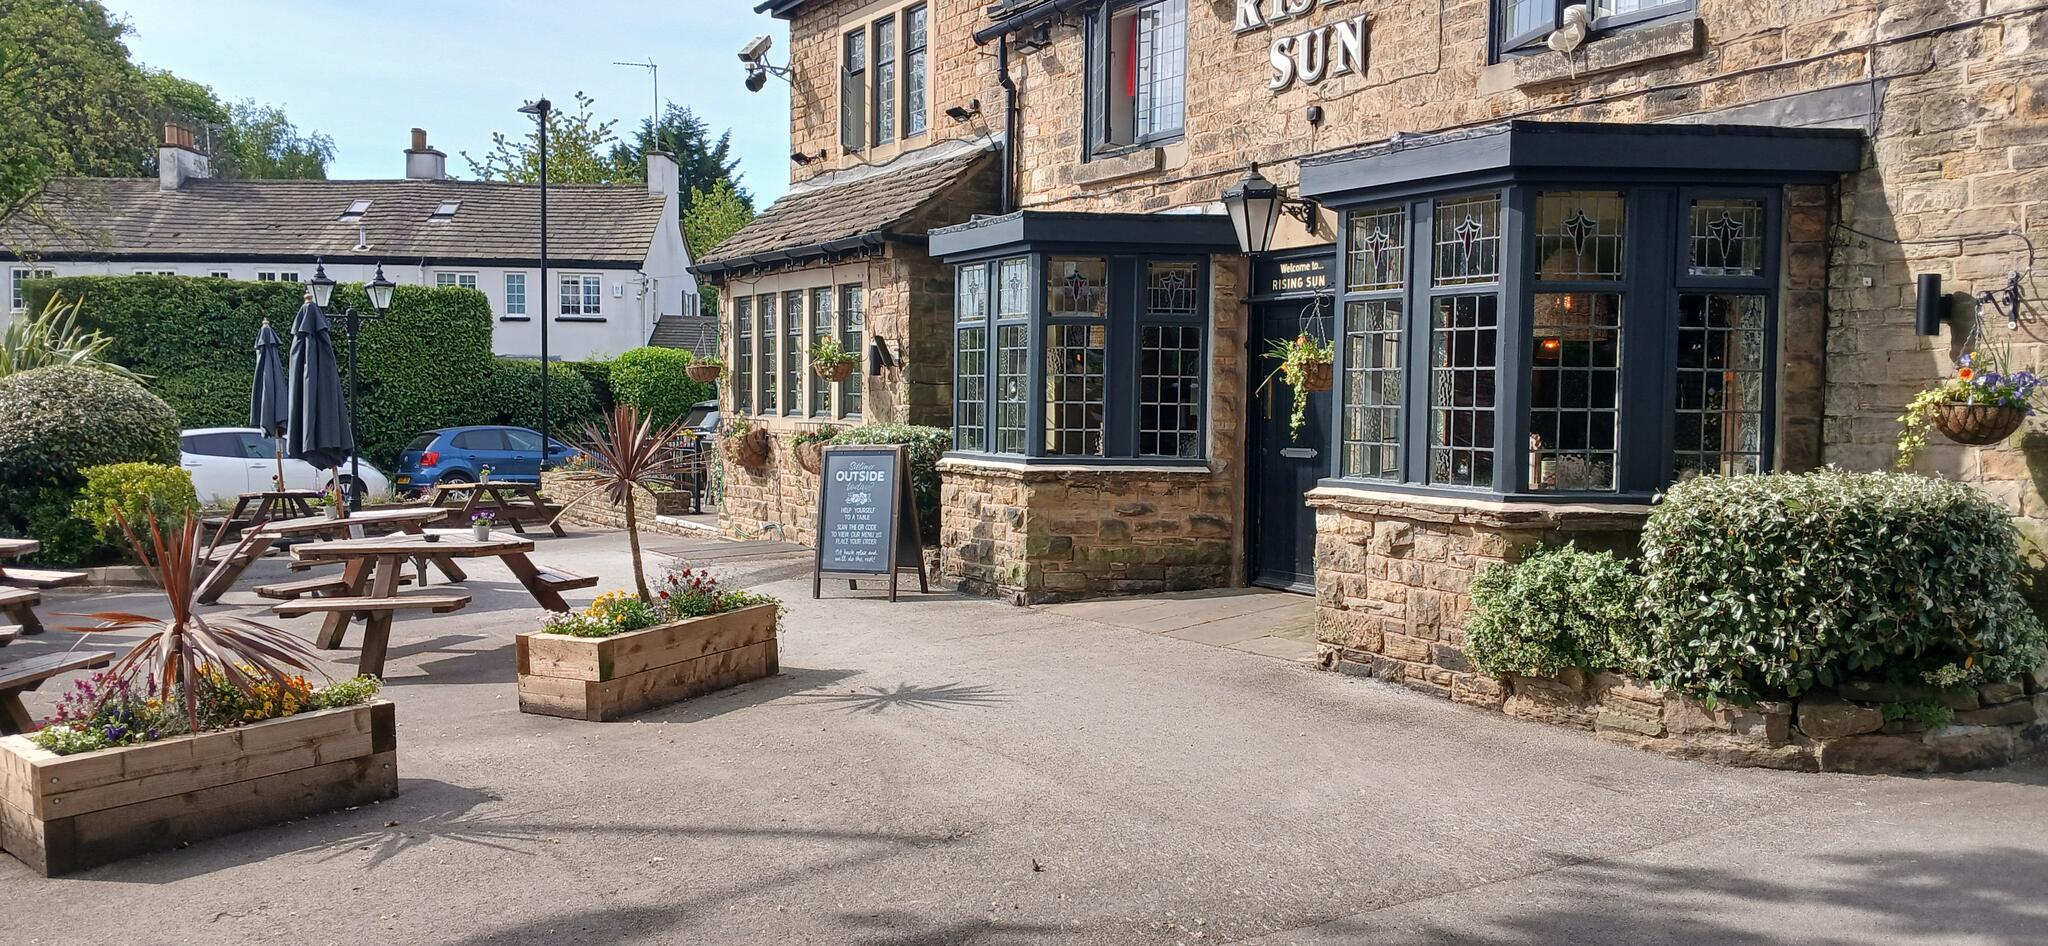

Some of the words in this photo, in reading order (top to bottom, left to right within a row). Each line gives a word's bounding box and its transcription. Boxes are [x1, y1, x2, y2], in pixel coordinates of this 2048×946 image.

[1269, 14, 1367, 91] SUN
[1280, 262, 1311, 274] Welcome
[1273, 276, 1303, 290] RISING
[1306, 275, 1325, 287] SUN
[836, 471, 885, 481] OUTSIDE
